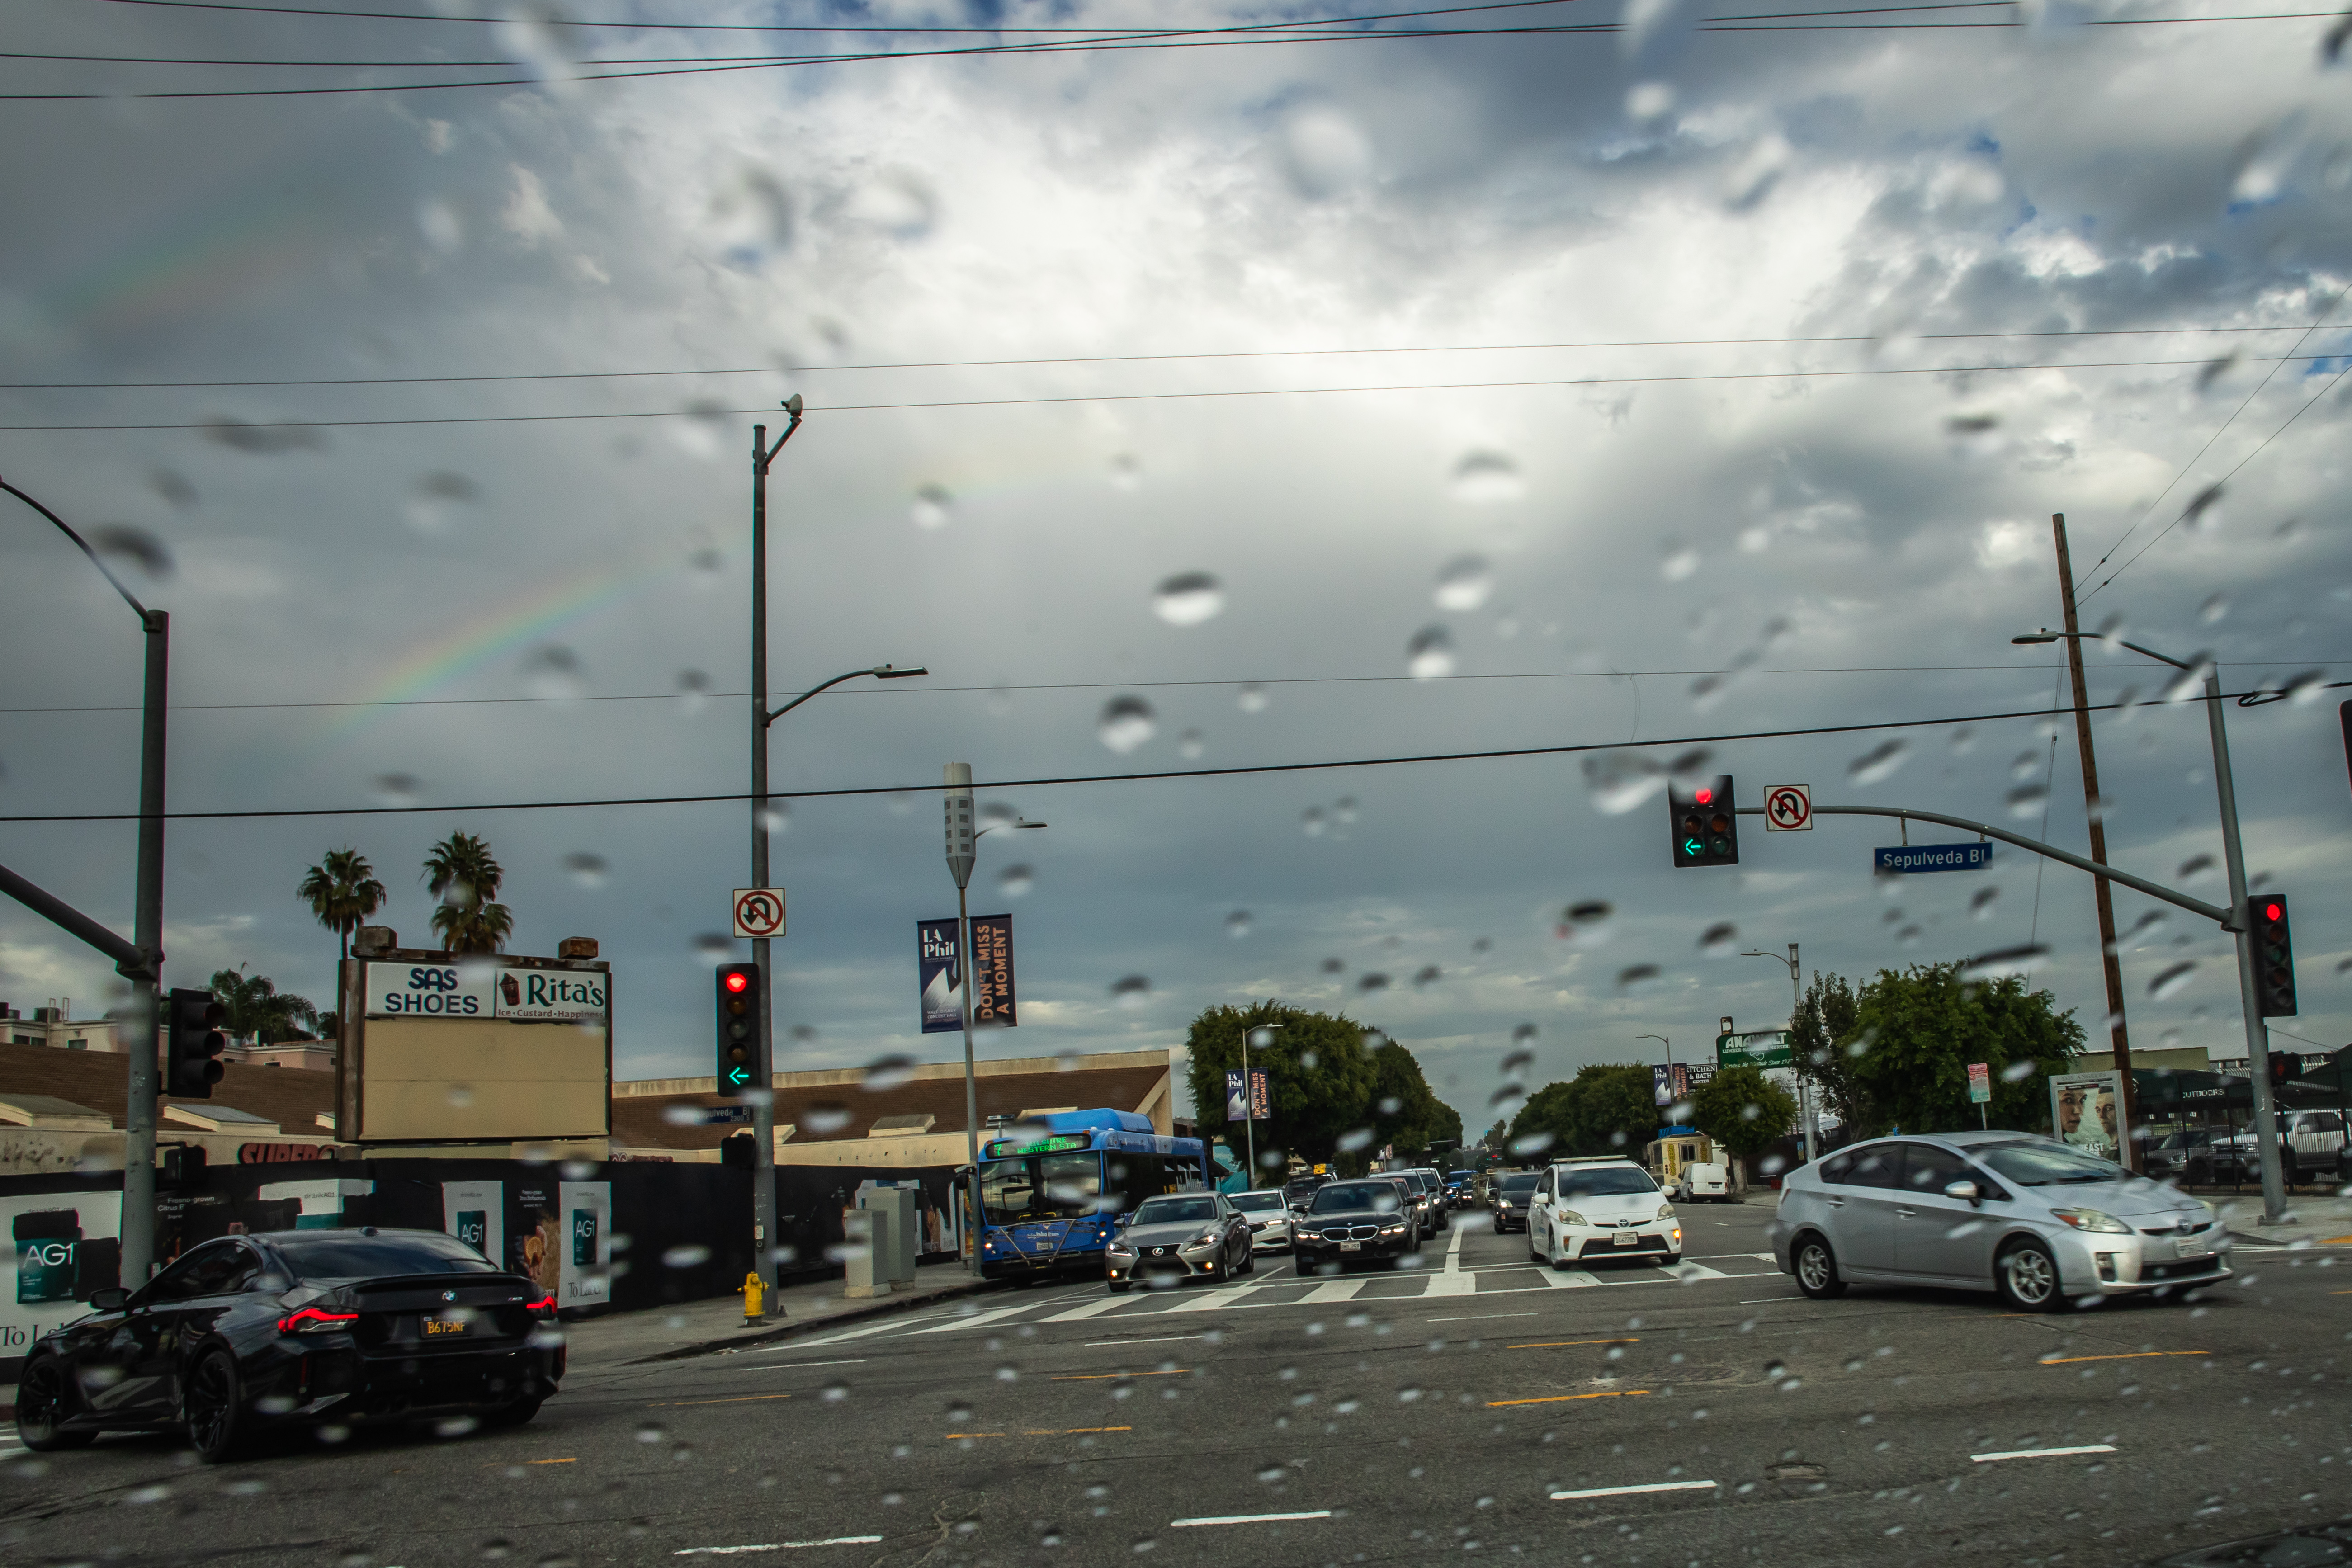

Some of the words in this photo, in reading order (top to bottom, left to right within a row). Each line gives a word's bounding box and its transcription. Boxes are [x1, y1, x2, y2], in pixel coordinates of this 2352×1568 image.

[1883, 850, 1963, 869] Sepulveda
[1970, 849, 1984, 863] Bl
[923, 929, 943, 943] LA
[977, 925, 991, 961] MISS
[924, 941, 954, 958] Phil
[993, 927, 1008, 996] MOMENT
[408, 967, 458, 992] SAS
[527, 974, 605, 1008] Rita's
[979, 968, 994, 1019] DON'T
[385, 992, 479, 1014] SHOES
[997, 1002, 1010, 1014] A
[498, 1009, 511, 1017] Ice
[517, 1009, 552, 1018] Custard
[1259, 1073, 1267, 1105] MOMENT
[742, 1106, 750, 1115] Bl
[994, 1143, 1002, 1156] 7
[1017, 1144, 1057, 1154] WESTERN
[157, 1204, 178, 1212] Citrus
[462, 1223, 483, 1243] AG1
[576, 1220, 595, 1238] AG1
[23, 1243, 74, 1268] AG1
[568, 1281, 578, 1298] To
[0, 1326, 26, 1346] To
